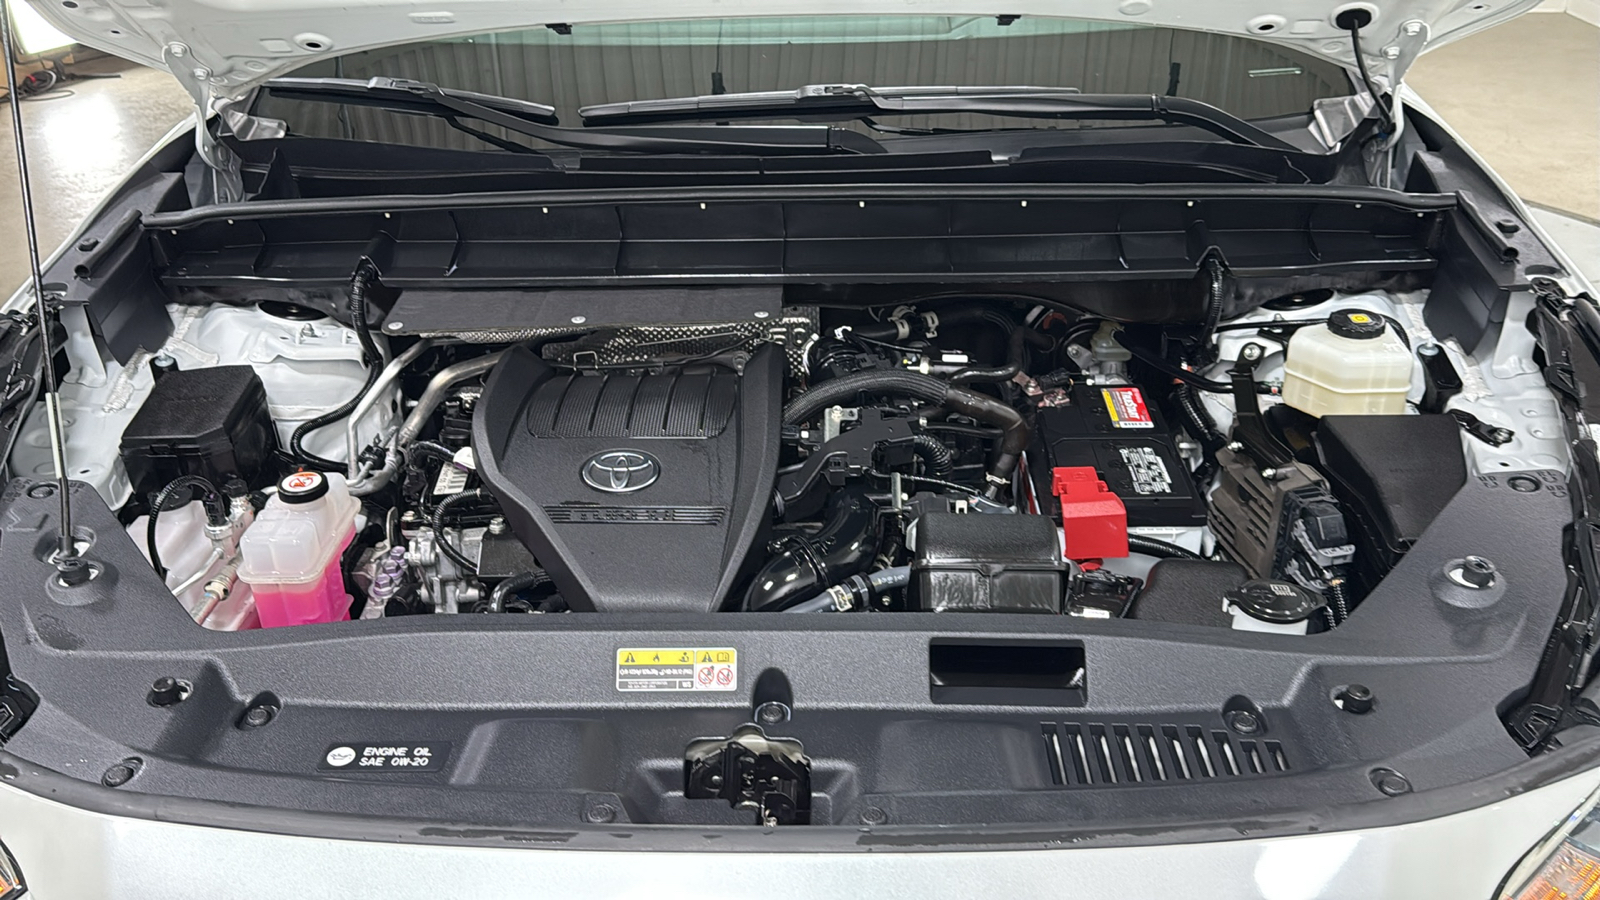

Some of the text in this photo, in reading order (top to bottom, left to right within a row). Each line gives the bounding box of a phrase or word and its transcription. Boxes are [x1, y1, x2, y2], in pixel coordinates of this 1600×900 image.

[363, 747, 432, 756] ENGINE OIL
[359, 757, 429, 766] SAE 0W-20
